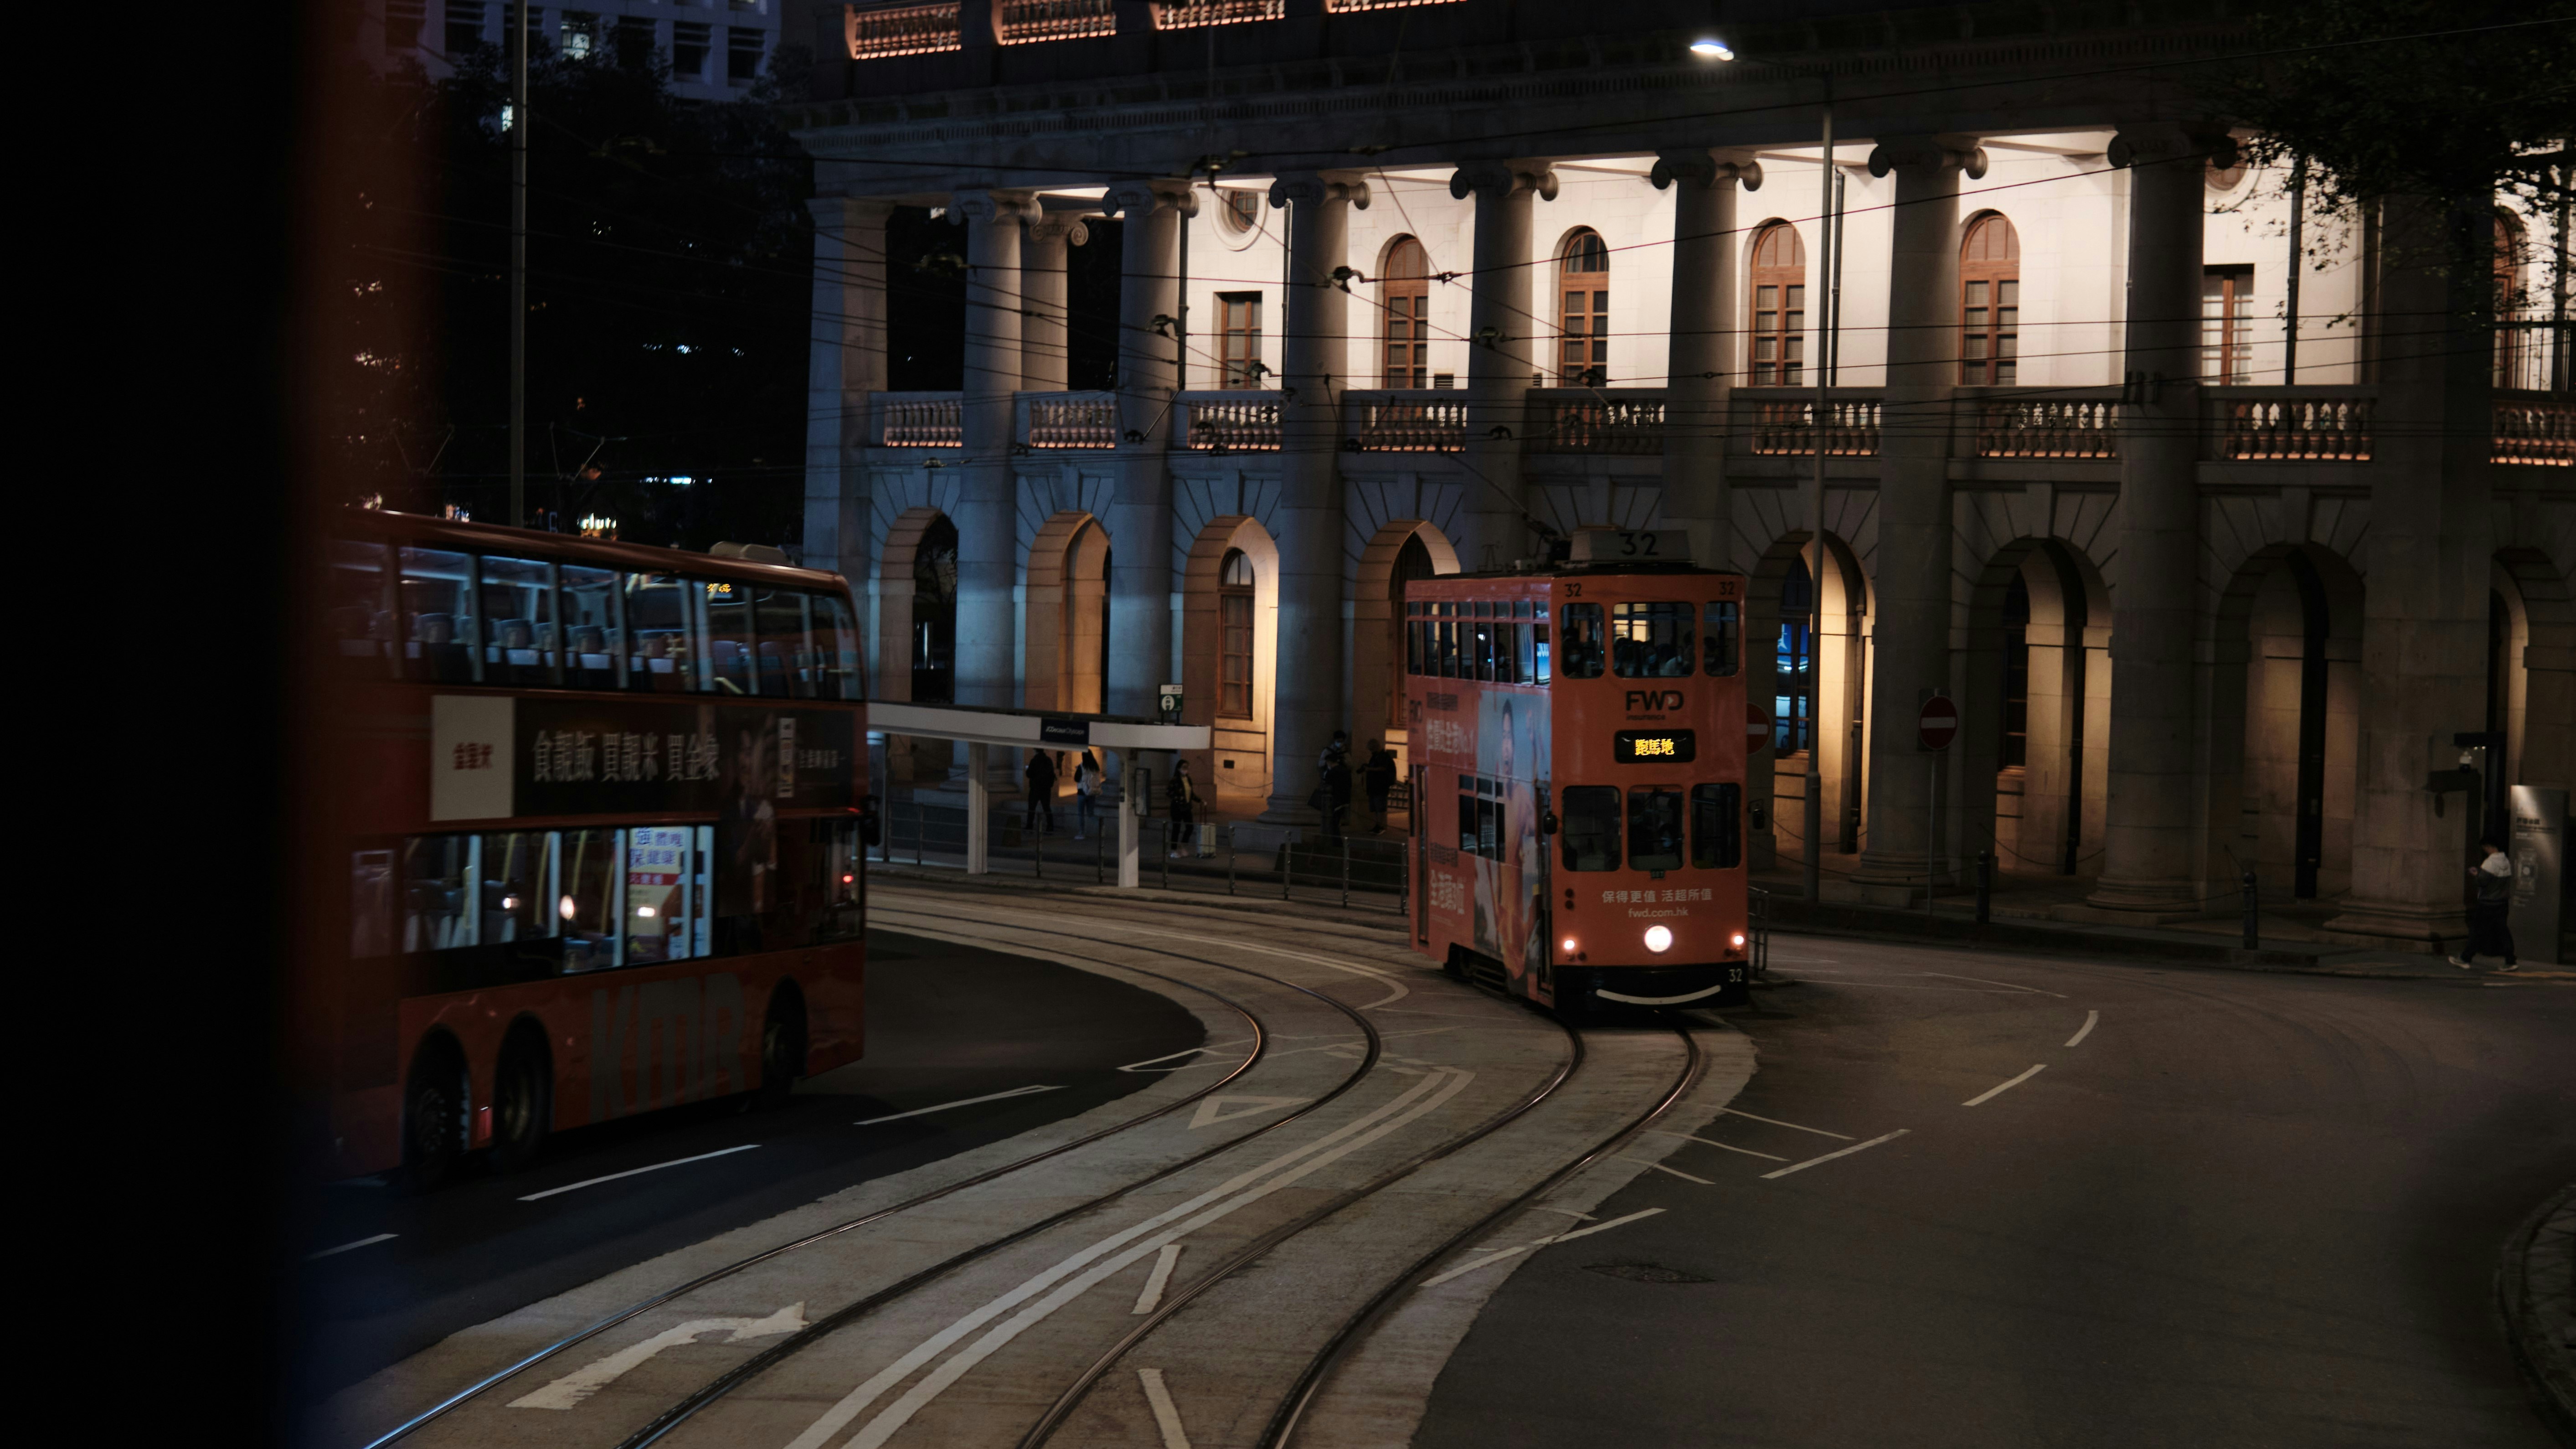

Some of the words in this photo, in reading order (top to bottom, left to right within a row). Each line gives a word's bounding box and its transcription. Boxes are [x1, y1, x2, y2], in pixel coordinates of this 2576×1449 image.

[1619, 532, 1658, 555] 32
[1565, 583, 1582, 597] 32
[1719, 582, 1734, 595] 32
[1626, 690, 1684, 711] FWD
[1635, 738, 1675, 756] 跑馬地
[1602, 890, 1657, 903] 保得更值
[1661, 888, 1712, 902] 活超所值
[1628, 907, 1689, 918] fwd.com.hk
[1728, 968, 1743, 982] 32
